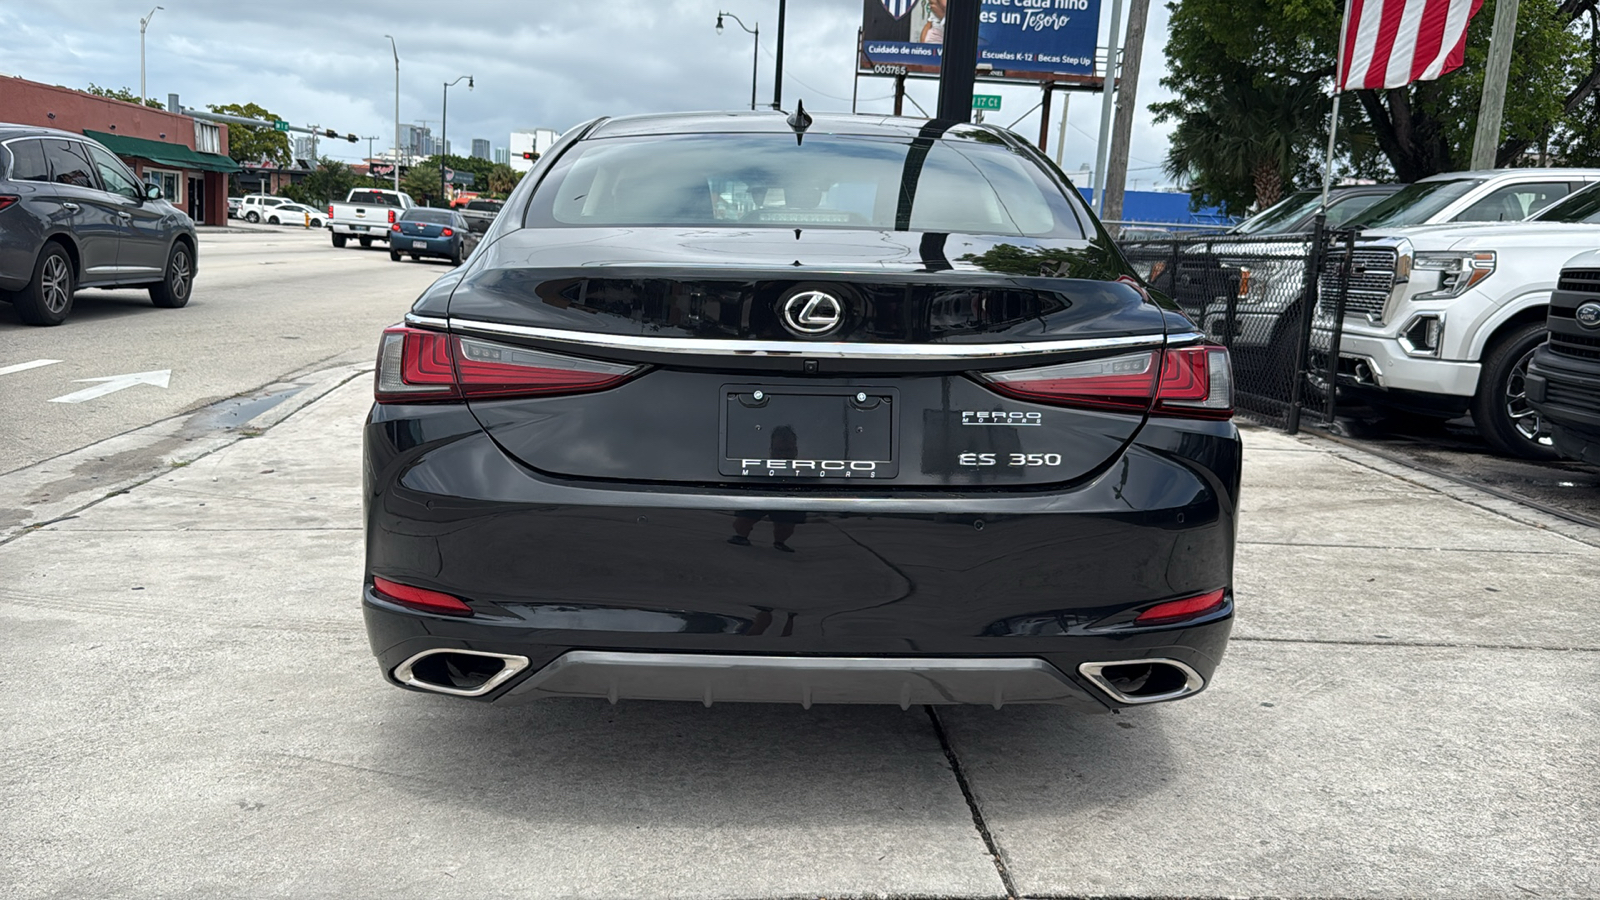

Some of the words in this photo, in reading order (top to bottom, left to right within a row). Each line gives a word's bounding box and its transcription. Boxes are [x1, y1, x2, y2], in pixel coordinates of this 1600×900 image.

[979, 11, 997, 23] es
[1001, 12, 1021, 25] un
[1021, 8, 1070, 31] Tesoro
[868, 44, 899, 54] Cuidado
[900, 45, 910, 55] de
[911, 46, 932, 56] niños
[981, 50, 1015, 60] Escuelas
[1016, 53, 1033, 61] K-12
[1038, 54, 1060, 63] Becas
[1061, 55, 1079, 66] Step
[1080, 57, 1091, 66] Up
[874, 64, 906, 75] 003785
[977, 97, 987, 106] 17
[988, 97, 998, 107] Ct
[962, 411, 1042, 419] FERCO
[742, 459, 876, 470] FERCO
[959, 453, 997, 466] ES
[1009, 453, 1062, 466] 350
[742, 470, 876, 478] MOTORS
